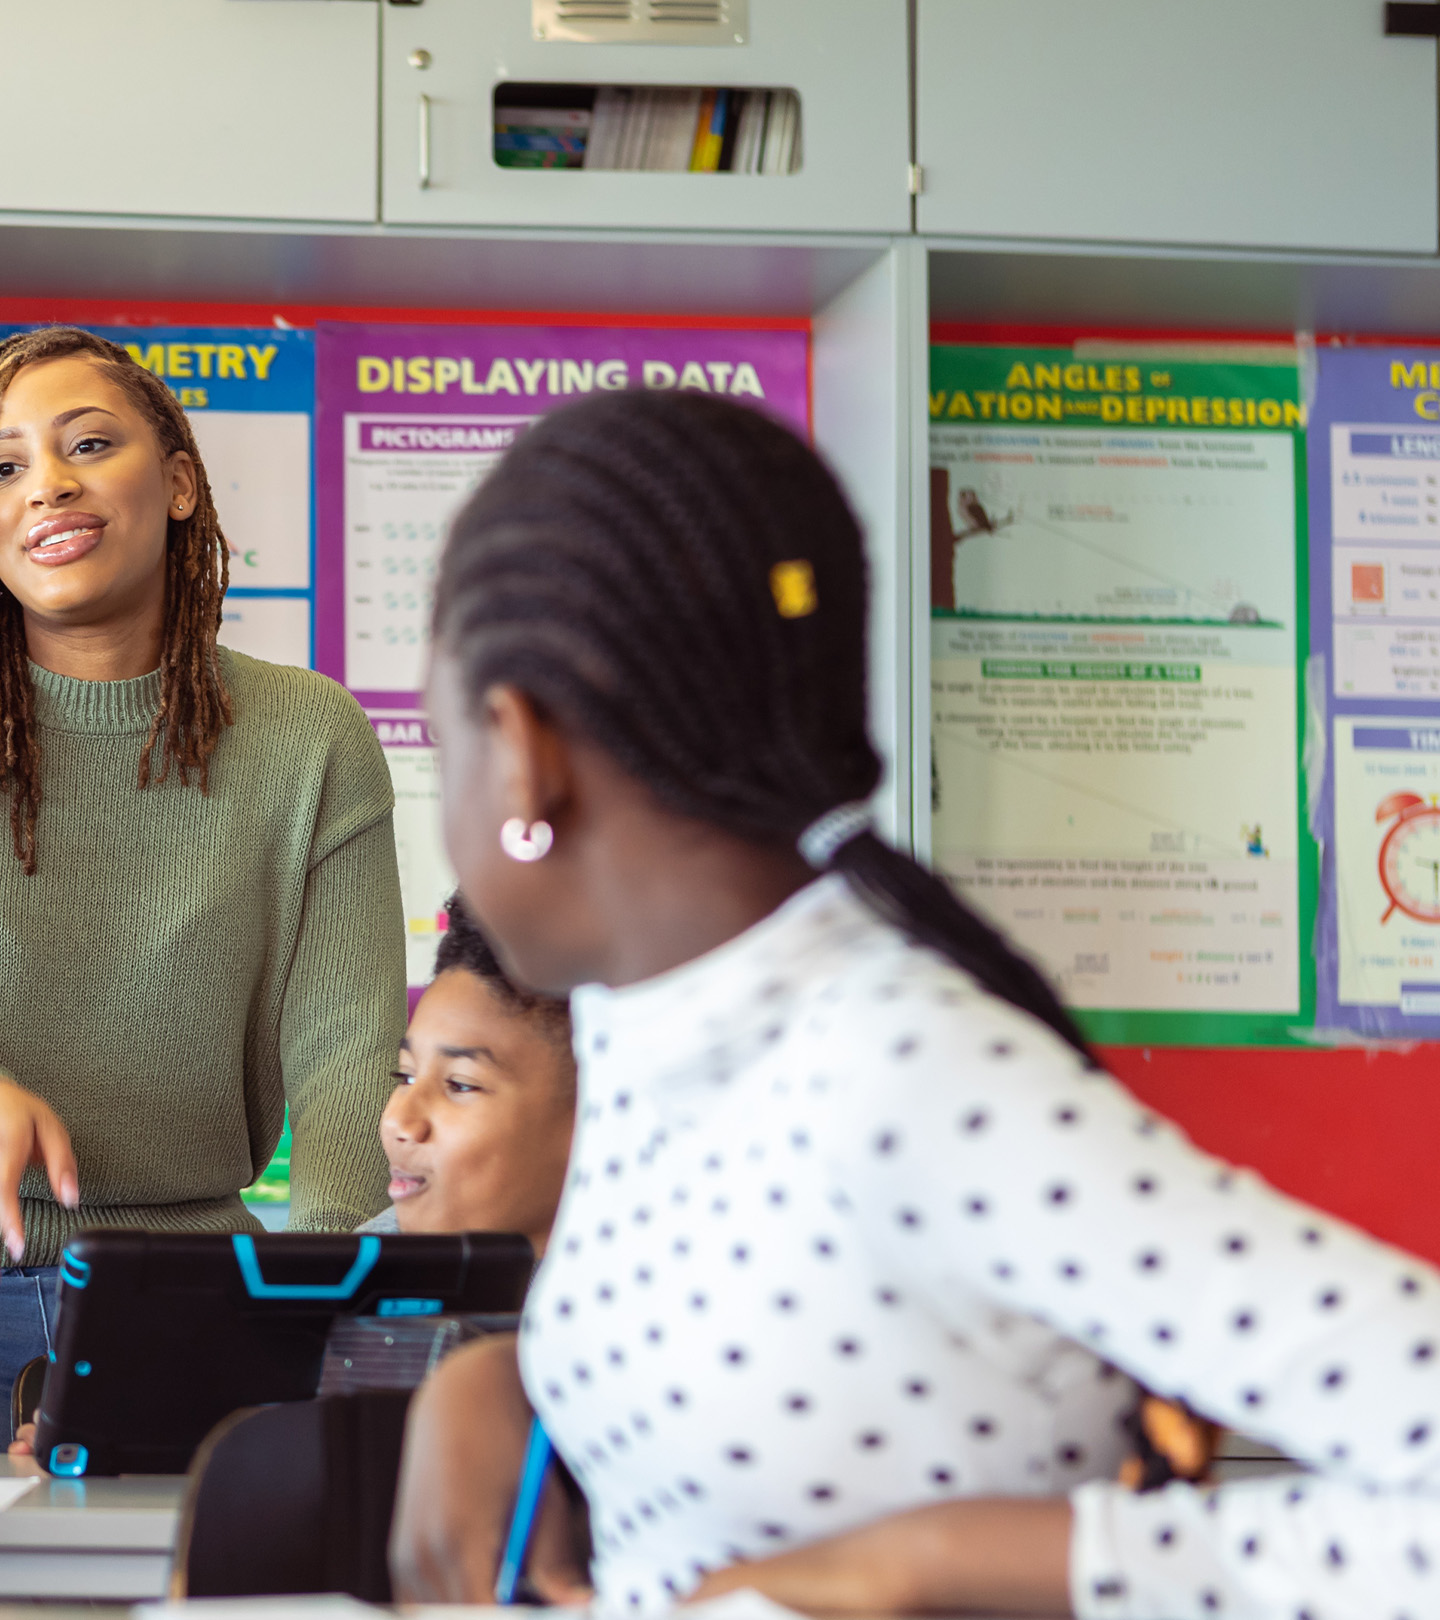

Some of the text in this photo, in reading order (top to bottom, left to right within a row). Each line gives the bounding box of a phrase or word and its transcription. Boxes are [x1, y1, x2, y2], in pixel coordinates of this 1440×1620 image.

[357, 356, 766, 399] DISPLAYING DATA
[1005, 361, 1142, 393] ANGLES
[929, 391, 1062, 421] VATION
[1100, 394, 1306, 427] DEPRESSION
[371, 426, 516, 449] PICTOGRAMS
[376, 720, 423, 745] BAR
